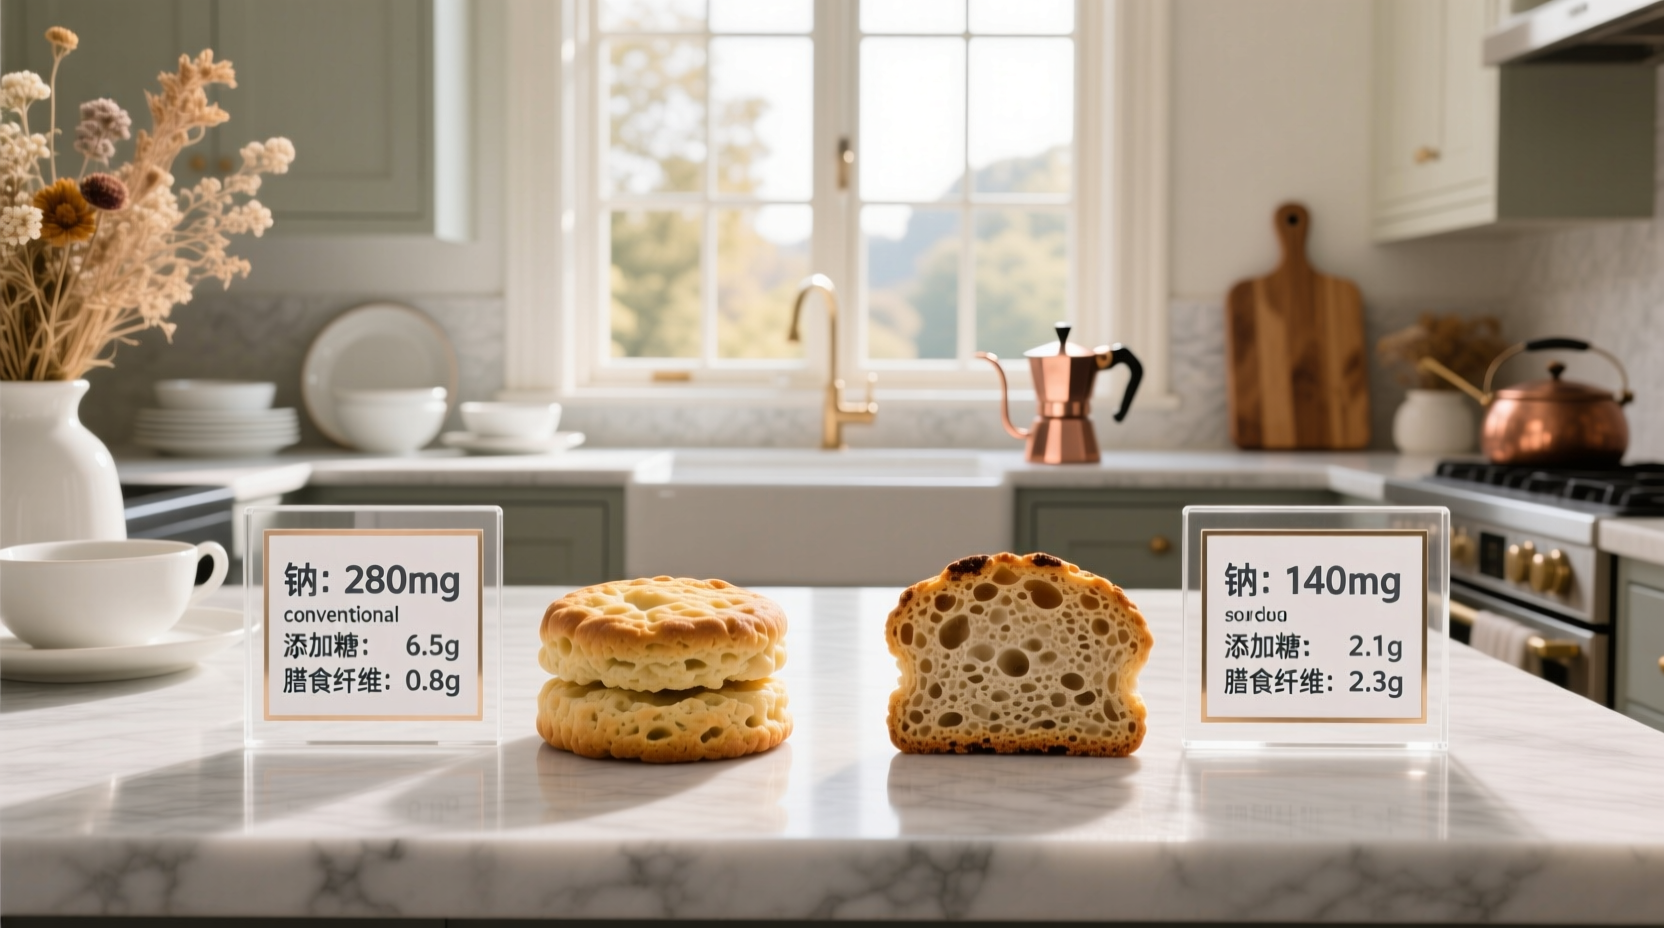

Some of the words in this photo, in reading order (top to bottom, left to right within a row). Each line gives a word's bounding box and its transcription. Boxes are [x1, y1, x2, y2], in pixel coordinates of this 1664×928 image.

[345, 564, 460, 602] 280mg
[1286, 565, 1401, 603] 140mg
[284, 605, 399, 623] conventional
[406, 634, 459, 661] 6.5g
[1349, 635, 1402, 662] 2.1g
[405, 669, 460, 697] 0.8g
[1349, 670, 1403, 698] 2.3g
